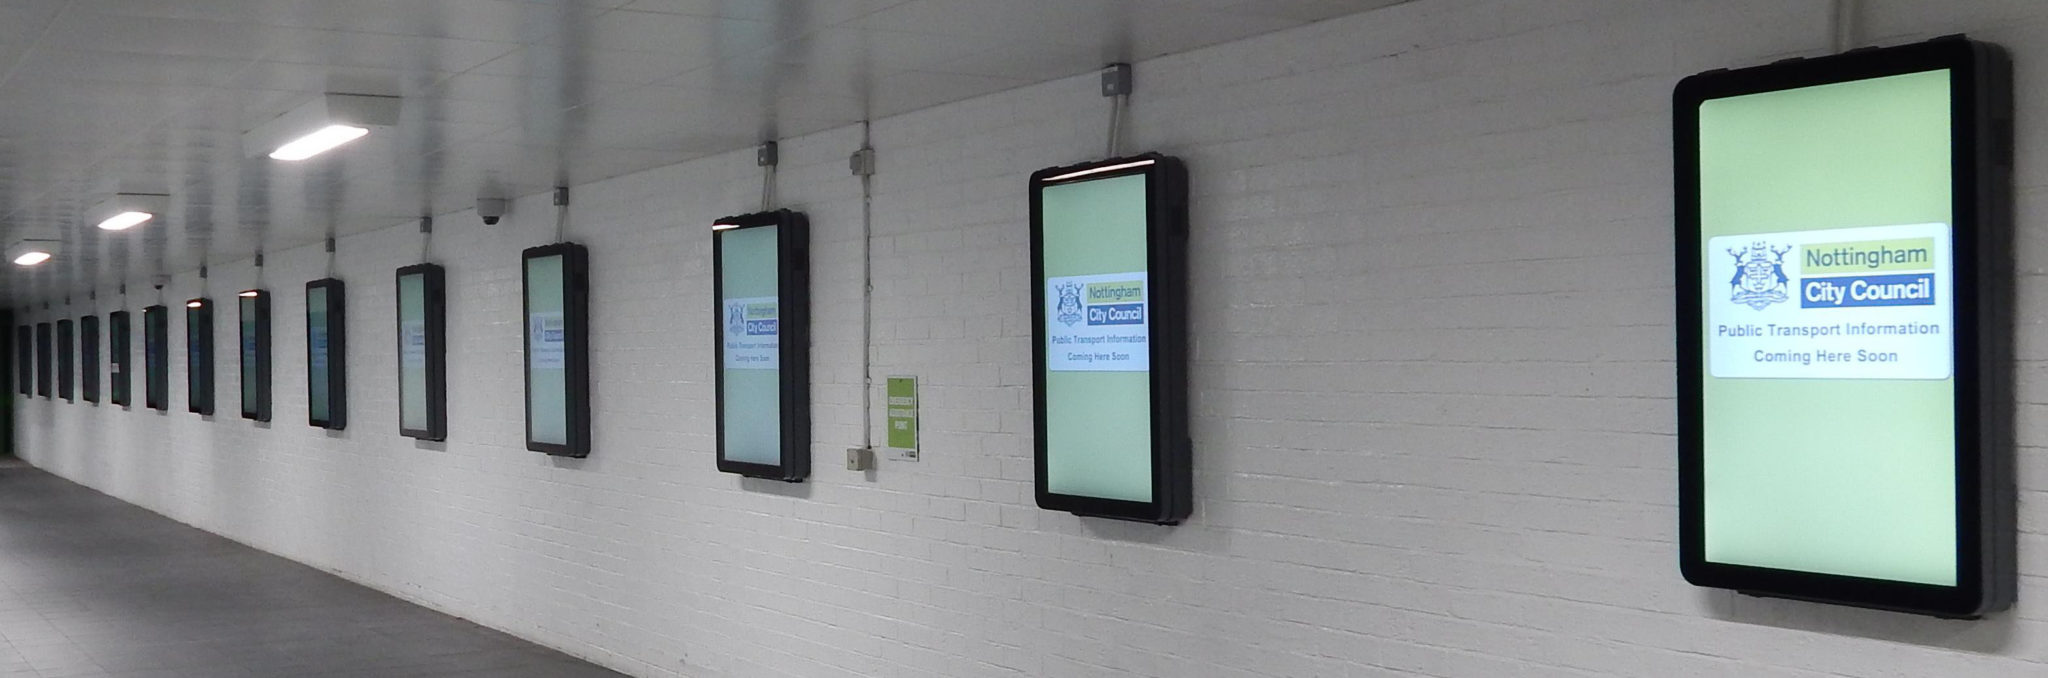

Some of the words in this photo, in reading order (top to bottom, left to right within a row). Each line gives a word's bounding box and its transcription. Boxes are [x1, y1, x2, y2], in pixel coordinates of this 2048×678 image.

[1806, 246, 1928, 269] Nottingham
[1089, 285, 1140, 300] Nottingham
[1805, 282, 1846, 305] City
[1850, 278, 1930, 301] Council
[1089, 308, 1107, 323] City
[1109, 307, 1142, 320] Council
[1718, 324, 1763, 337] Public
[1768, 323, 1841, 339] Transport
[1846, 321, 1940, 336] Information
[1052, 335, 1072, 344] Public
[1074, 335, 1106, 345] Transport
[1107, 334, 1147, 344] Information
[1067, 352, 1093, 363] Coming
[1094, 352, 1111, 361] Here
[1112, 352, 1129, 360] Soon
[1754, 349, 1811, 365] Coming
[1816, 349, 1852, 362] Here
[1857, 349, 1898, 362] Soon
